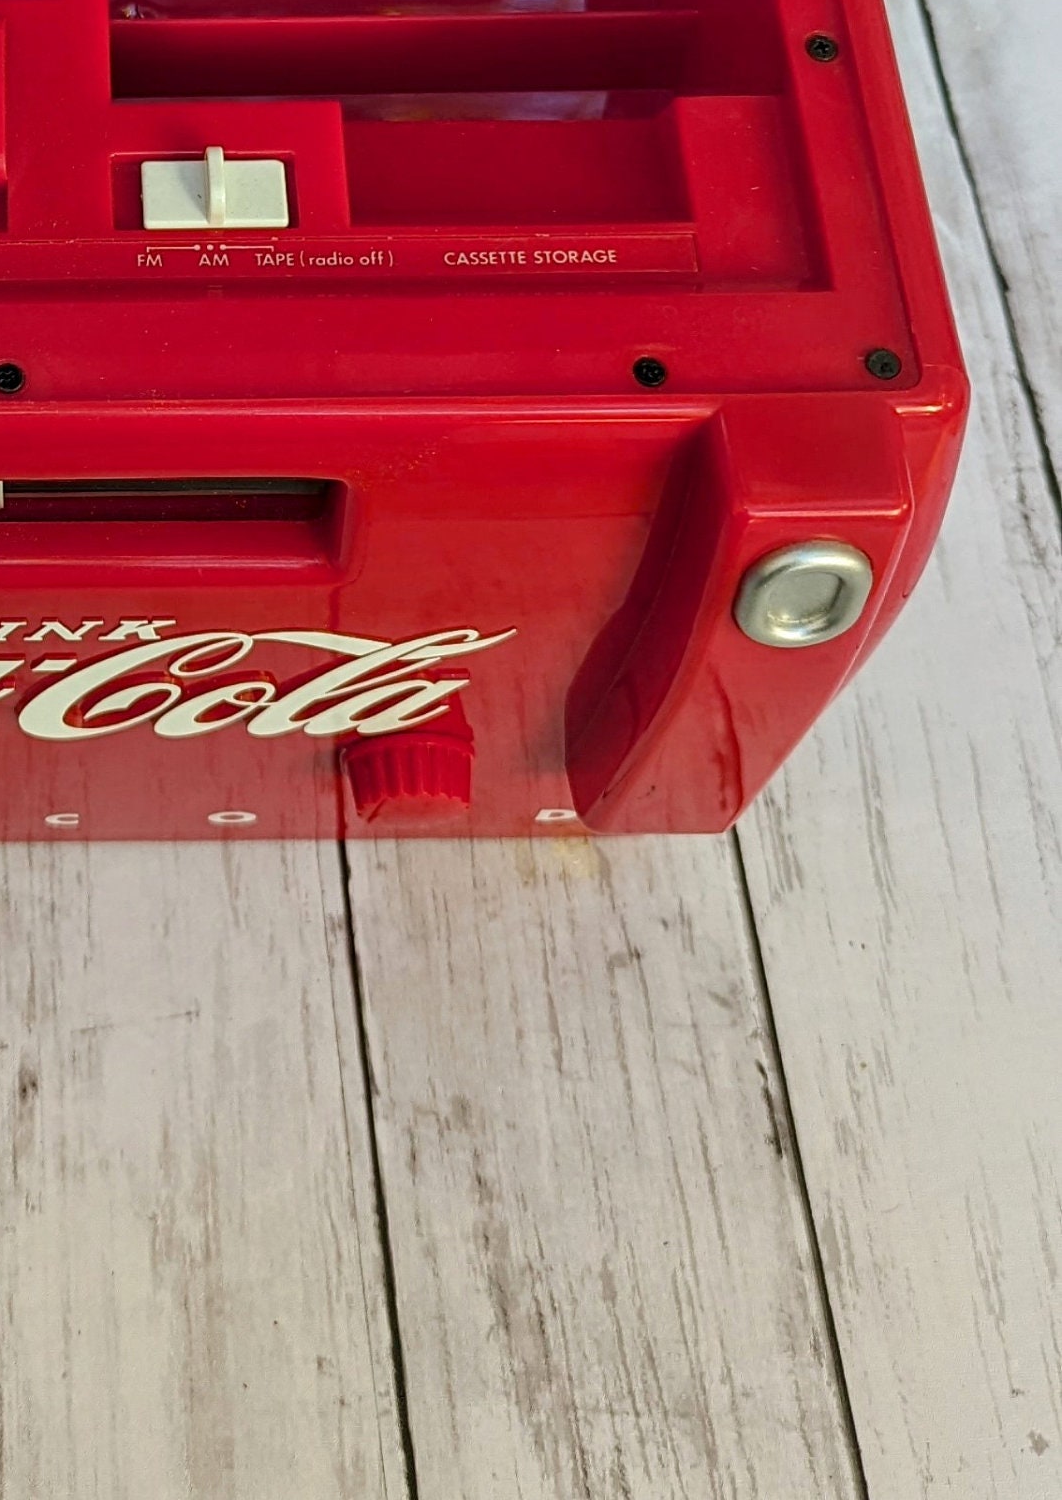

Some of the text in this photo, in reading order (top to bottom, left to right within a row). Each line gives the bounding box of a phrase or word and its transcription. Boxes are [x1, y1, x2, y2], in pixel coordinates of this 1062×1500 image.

[136, 253, 164, 268] FM
[198, 253, 230, 267] AM
[254, 250, 395, 267] TAPE (radio off)
[443, 249, 617, 266] CASSETTE STORAGE
